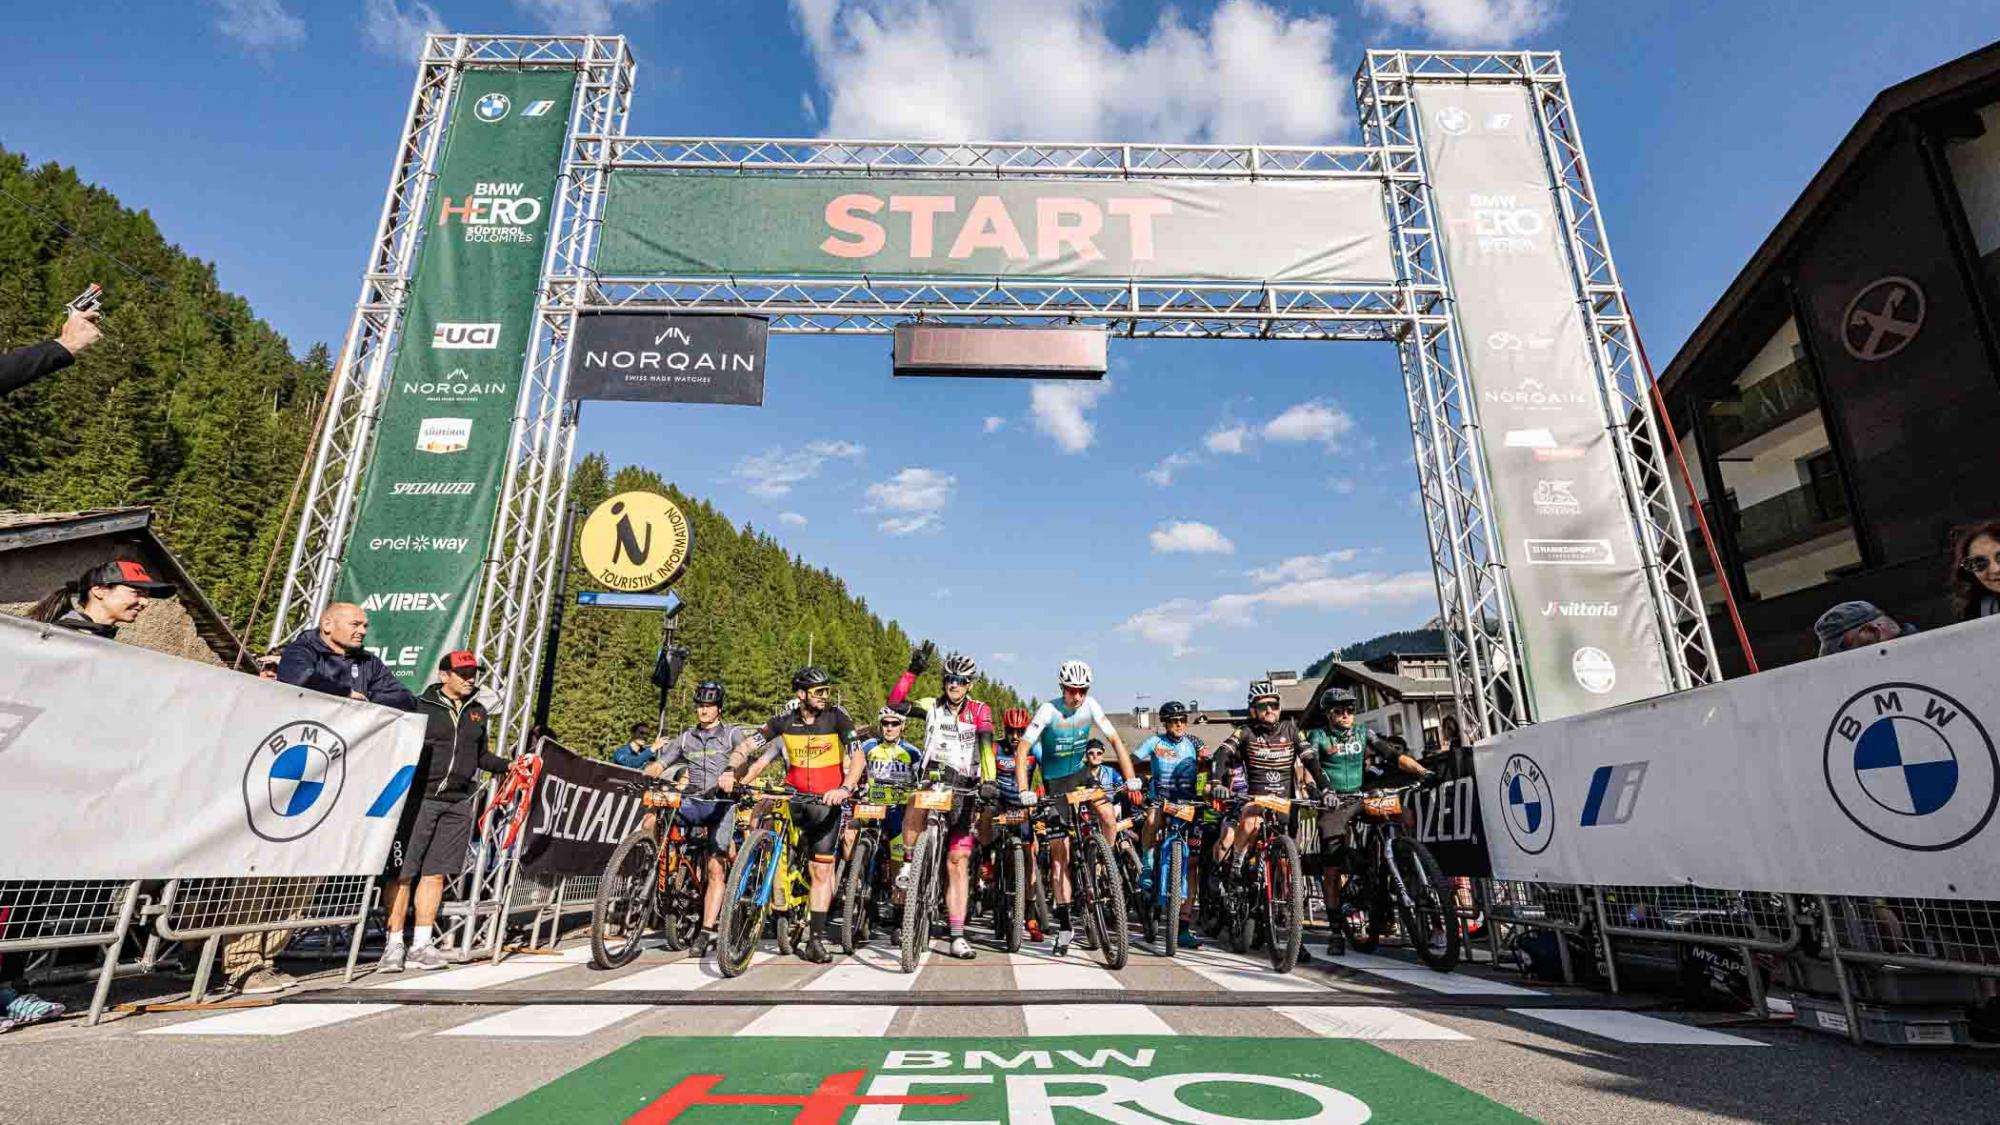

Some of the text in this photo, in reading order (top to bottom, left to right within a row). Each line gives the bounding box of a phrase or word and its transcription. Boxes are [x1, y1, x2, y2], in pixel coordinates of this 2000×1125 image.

[474, 183, 524, 196] BMW
[438, 195, 541, 226] HERO
[819, 193, 1173, 261] START
[465, 233, 533, 242] DOLOMITES
[445, 327, 494, 344] UCI
[585, 351, 754, 372] NORQAIN
[403, 383, 506, 395] NORQAIN
[650, 375, 671, 383] MADE
[389, 483, 476, 495] SPECIALIZED
[370, 536, 469, 554] enel way
[600, 507, 687, 589] TOURISTIK INFORMATION
[360, 593, 450, 611] AVIREX
[1560, 602, 1618, 616] vittoria
[1838, 691, 1957, 743] BMW
[268, 726, 342, 762] BMW
[1504, 758, 1540, 787] BMW
[533, 774, 641, 845] SPECIALI
[1692, 946, 1747, 977] MYLAPS
[882, 1049, 1157, 1069] BMW
